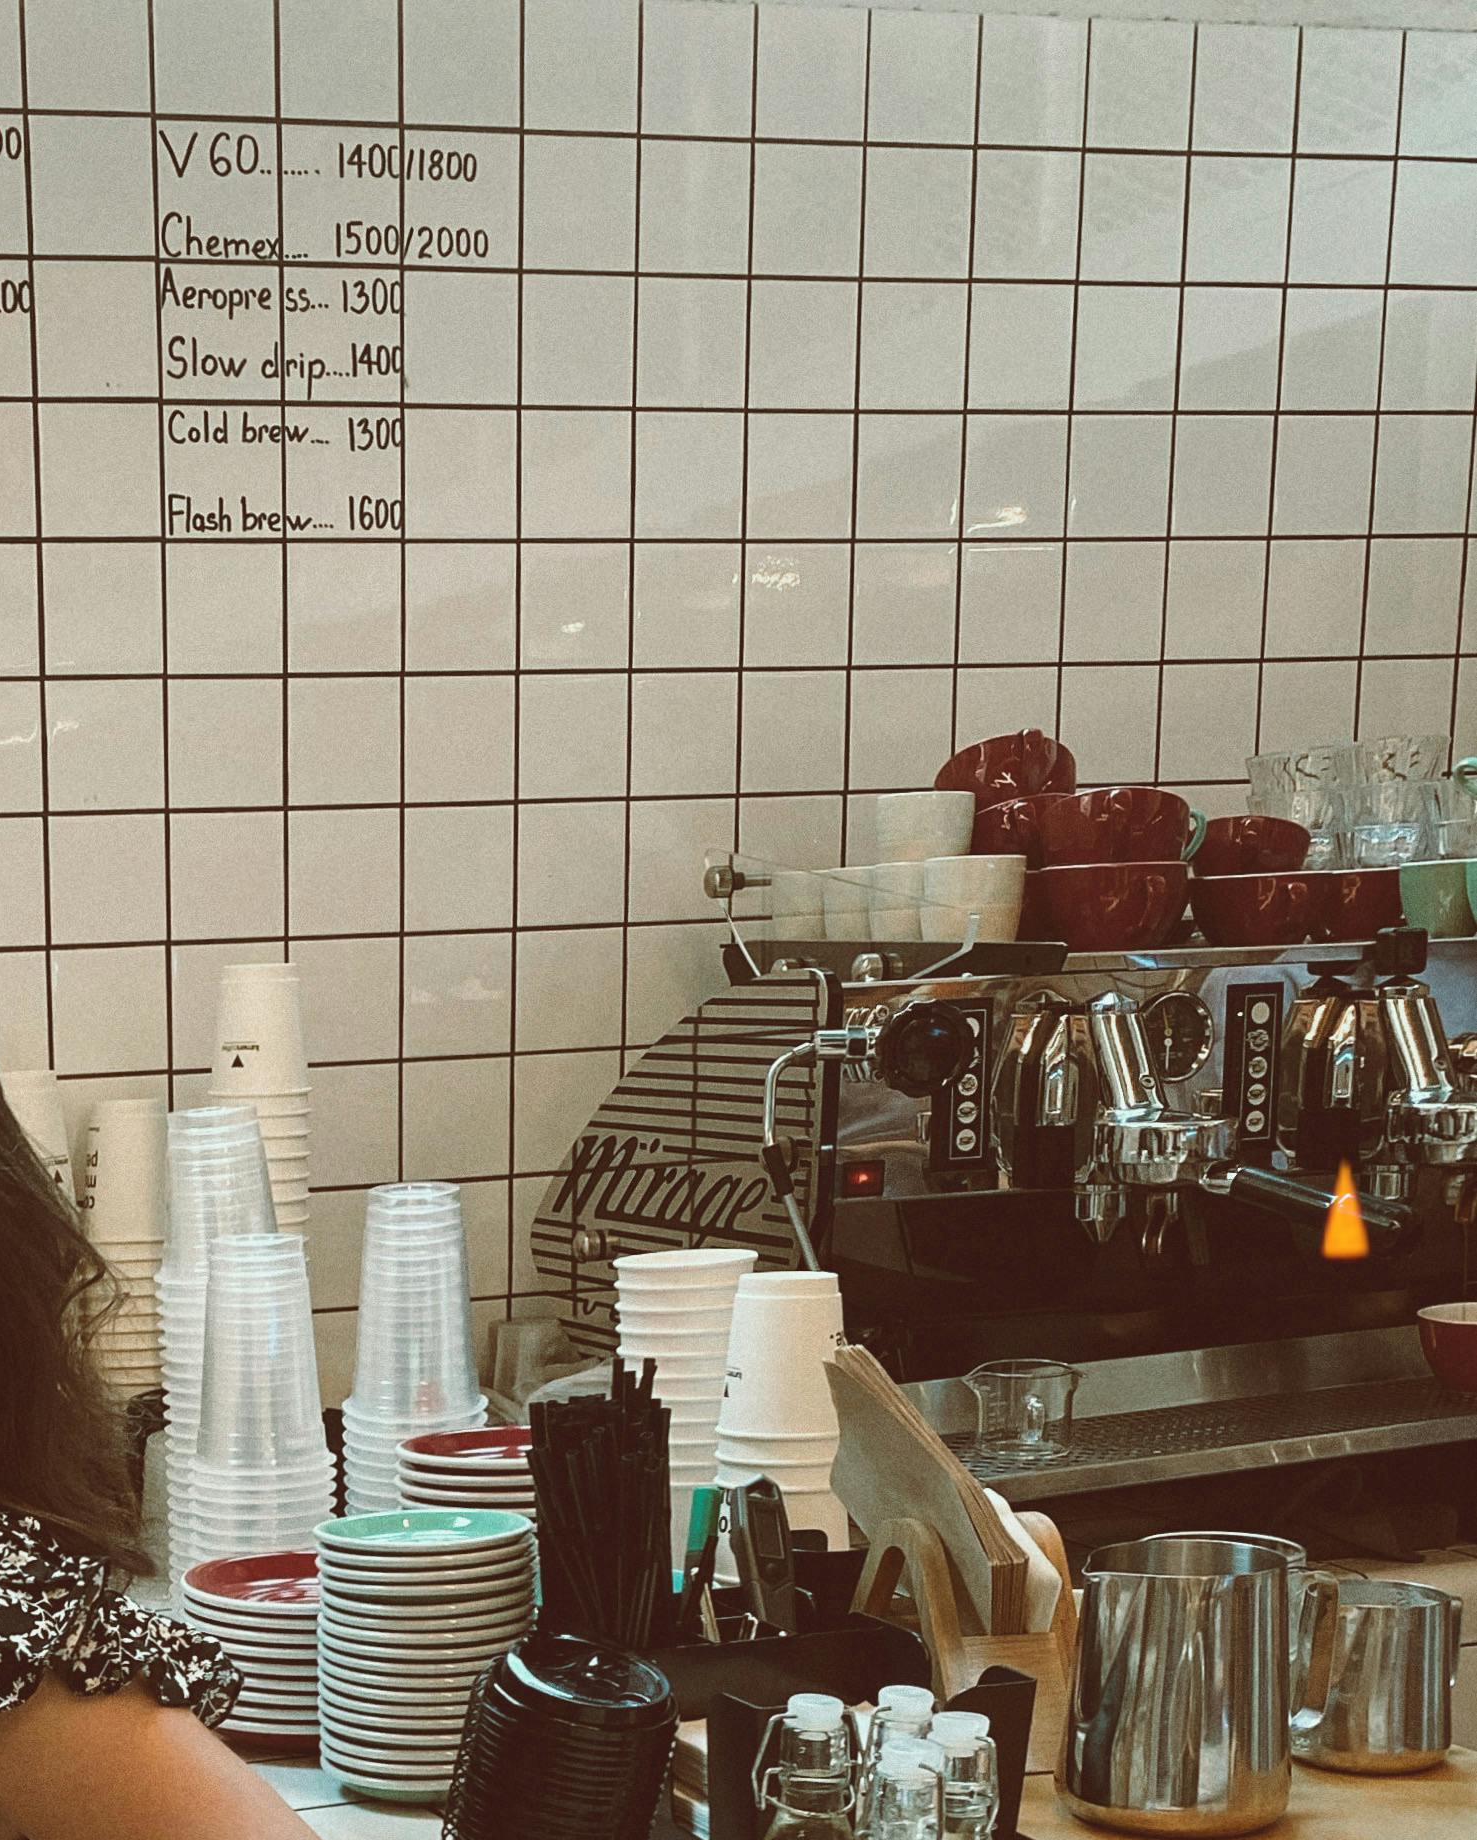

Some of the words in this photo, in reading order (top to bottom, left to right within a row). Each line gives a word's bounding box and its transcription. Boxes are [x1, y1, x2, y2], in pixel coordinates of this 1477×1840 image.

[338, 142, 478, 182] 1400/1800
[160, 212, 281, 259] Chemex
[335, 221, 489, 259] 1500/2000
[341, 278, 403, 316] 1300
[167, 336, 247, 379] Slow
[261, 341, 326, 399] drip
[351, 342, 403, 378] 1400
[167, 410, 229, 446] Cold
[241, 411, 310, 446] brew
[348, 417, 403, 452] 1300
[167, 493, 232, 536] Flash
[241, 495, 312, 533] brew
[348, 495, 403, 532] 1600
